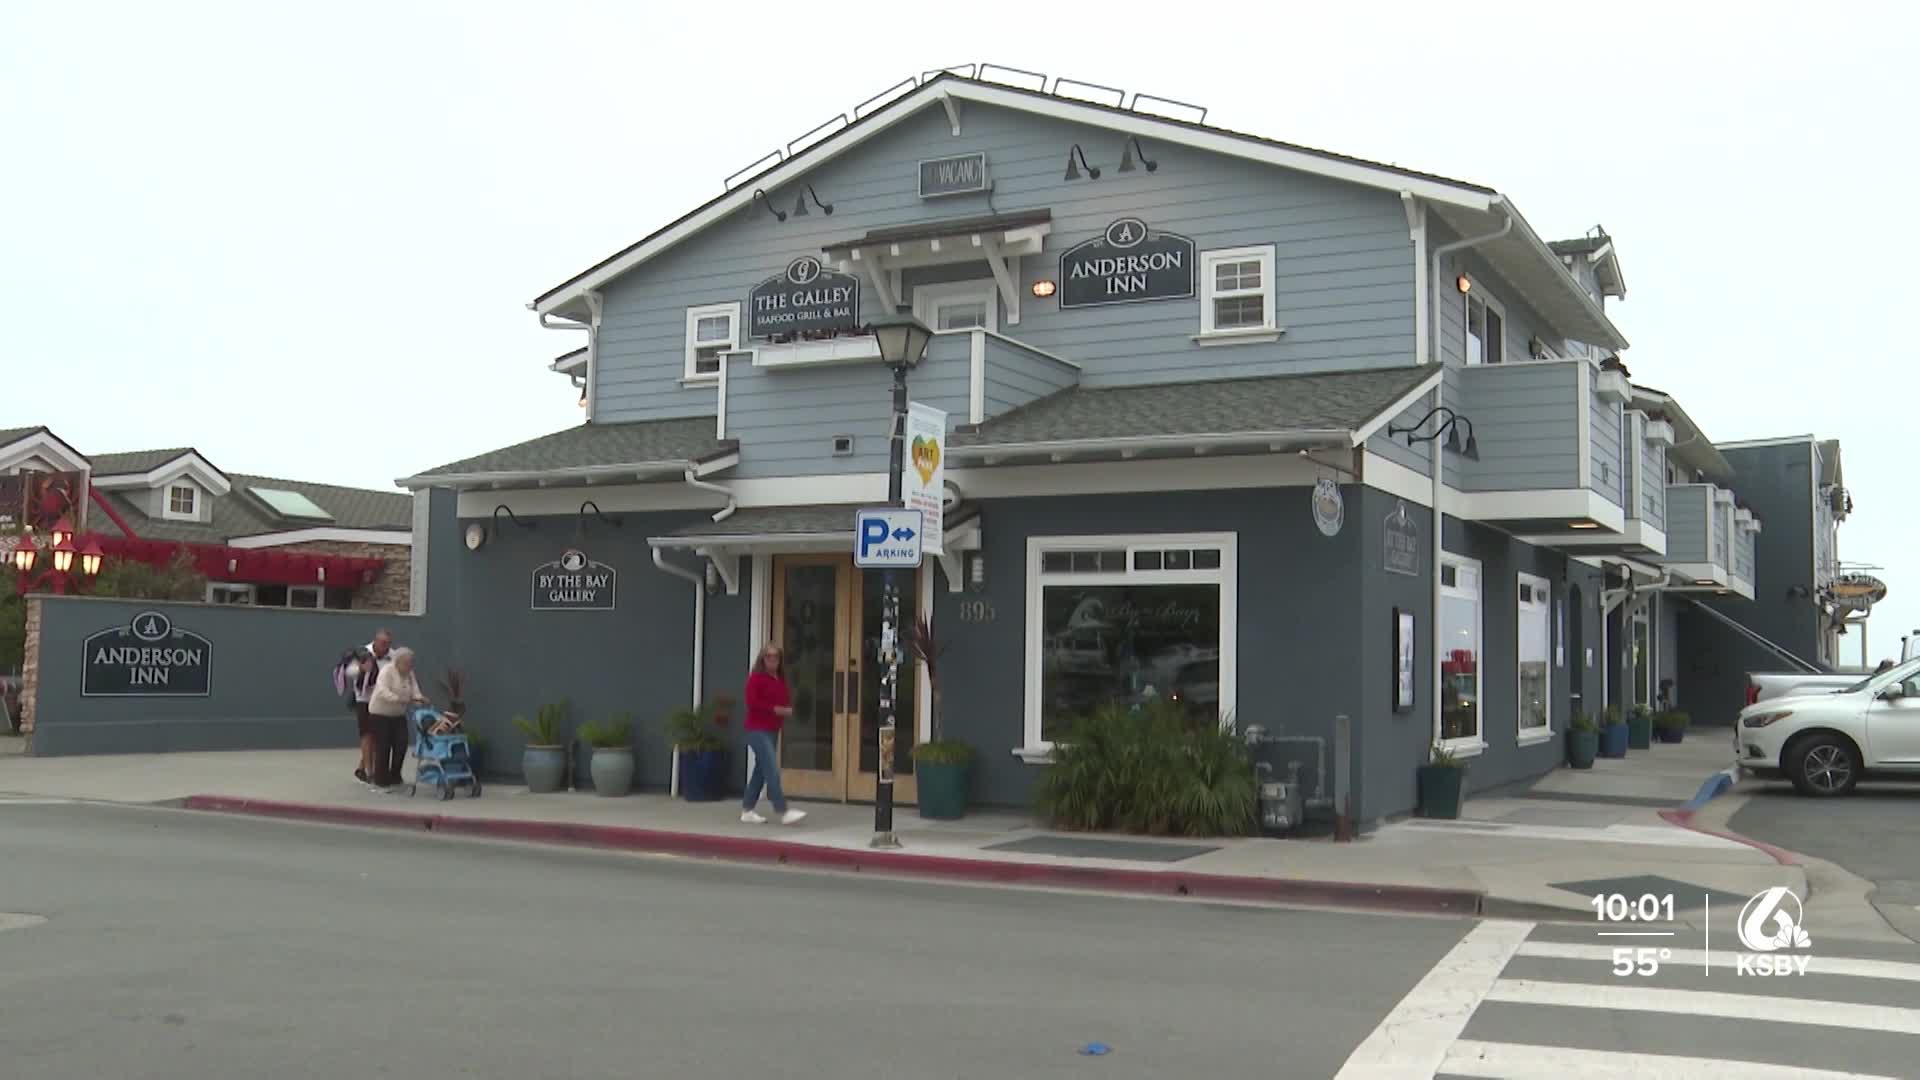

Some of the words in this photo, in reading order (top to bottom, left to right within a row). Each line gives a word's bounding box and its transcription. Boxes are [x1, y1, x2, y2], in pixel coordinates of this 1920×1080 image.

[939, 160, 983, 185] VACANCY
[1118, 223, 1133, 242] A
[1070, 251, 1182, 279] ANDERSON
[1106, 274, 1147, 294] INN
[756, 293, 787, 310] THE
[792, 286, 852, 306] GALLEY
[797, 310, 822, 321] GRILL
[823, 308, 832, 318] &
[833, 306, 851, 317] BAR
[540, 575, 554, 588] BY
[557, 575, 582, 588] THE
[586, 575, 608, 588] BAY
[549, 590, 596, 602] GALLERY
[960, 600, 997, 623] 895
[143, 616, 159, 635] A
[94, 647, 202, 666] ANDERSON
[130, 667, 170, 684] INN
